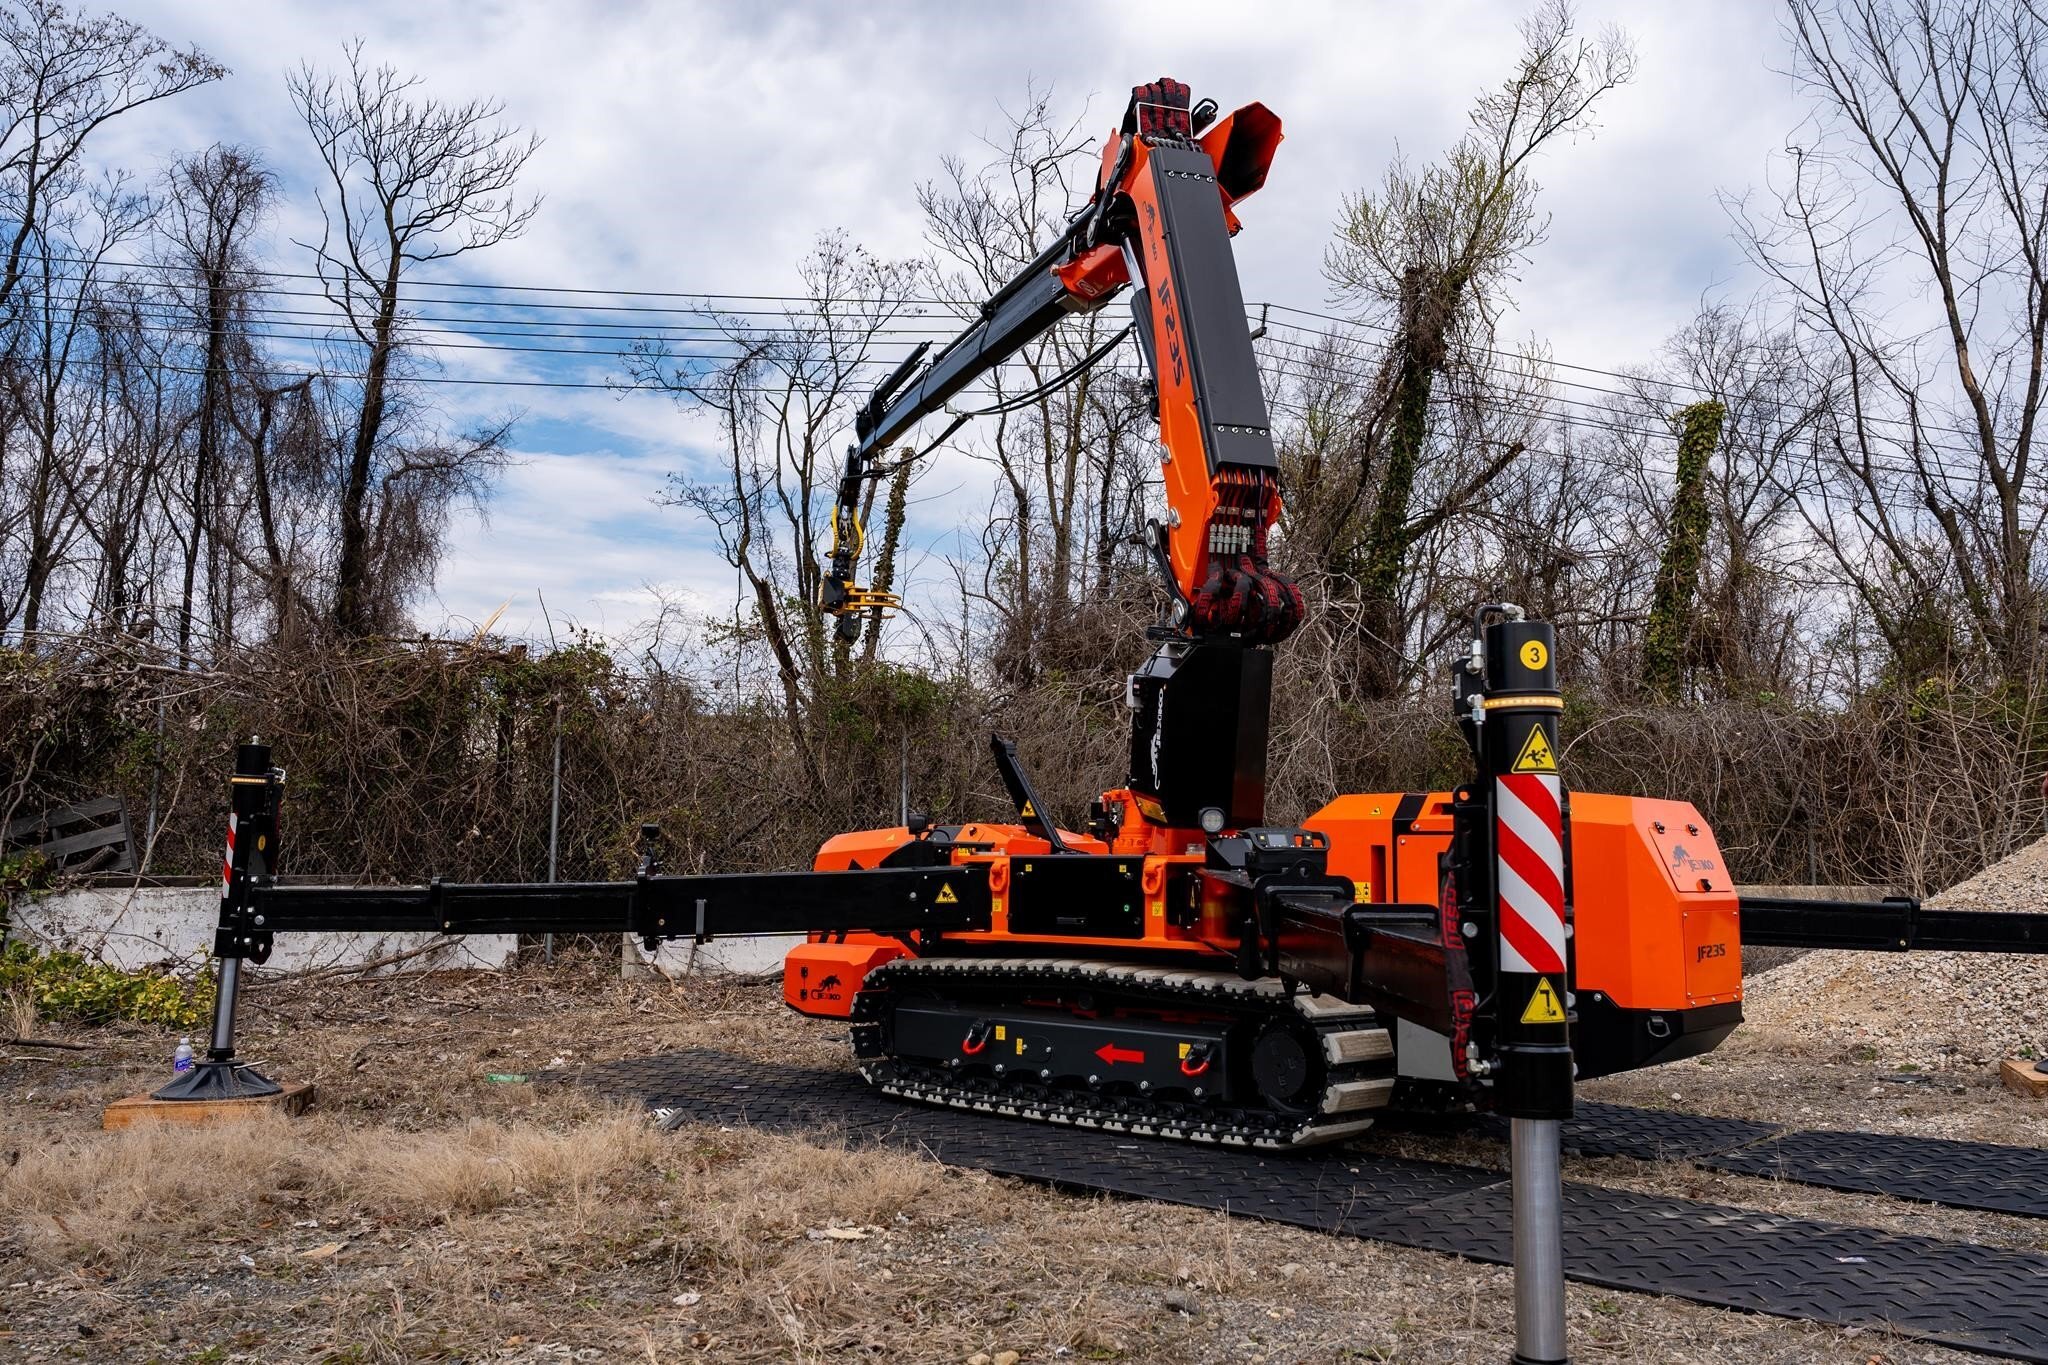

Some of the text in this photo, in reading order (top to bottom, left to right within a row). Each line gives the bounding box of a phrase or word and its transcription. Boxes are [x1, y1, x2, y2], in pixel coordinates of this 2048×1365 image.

[1157, 277, 1184, 386] JF235
[1530, 647, 1540, 663] 3
[1697, 943, 1725, 963] JF235
